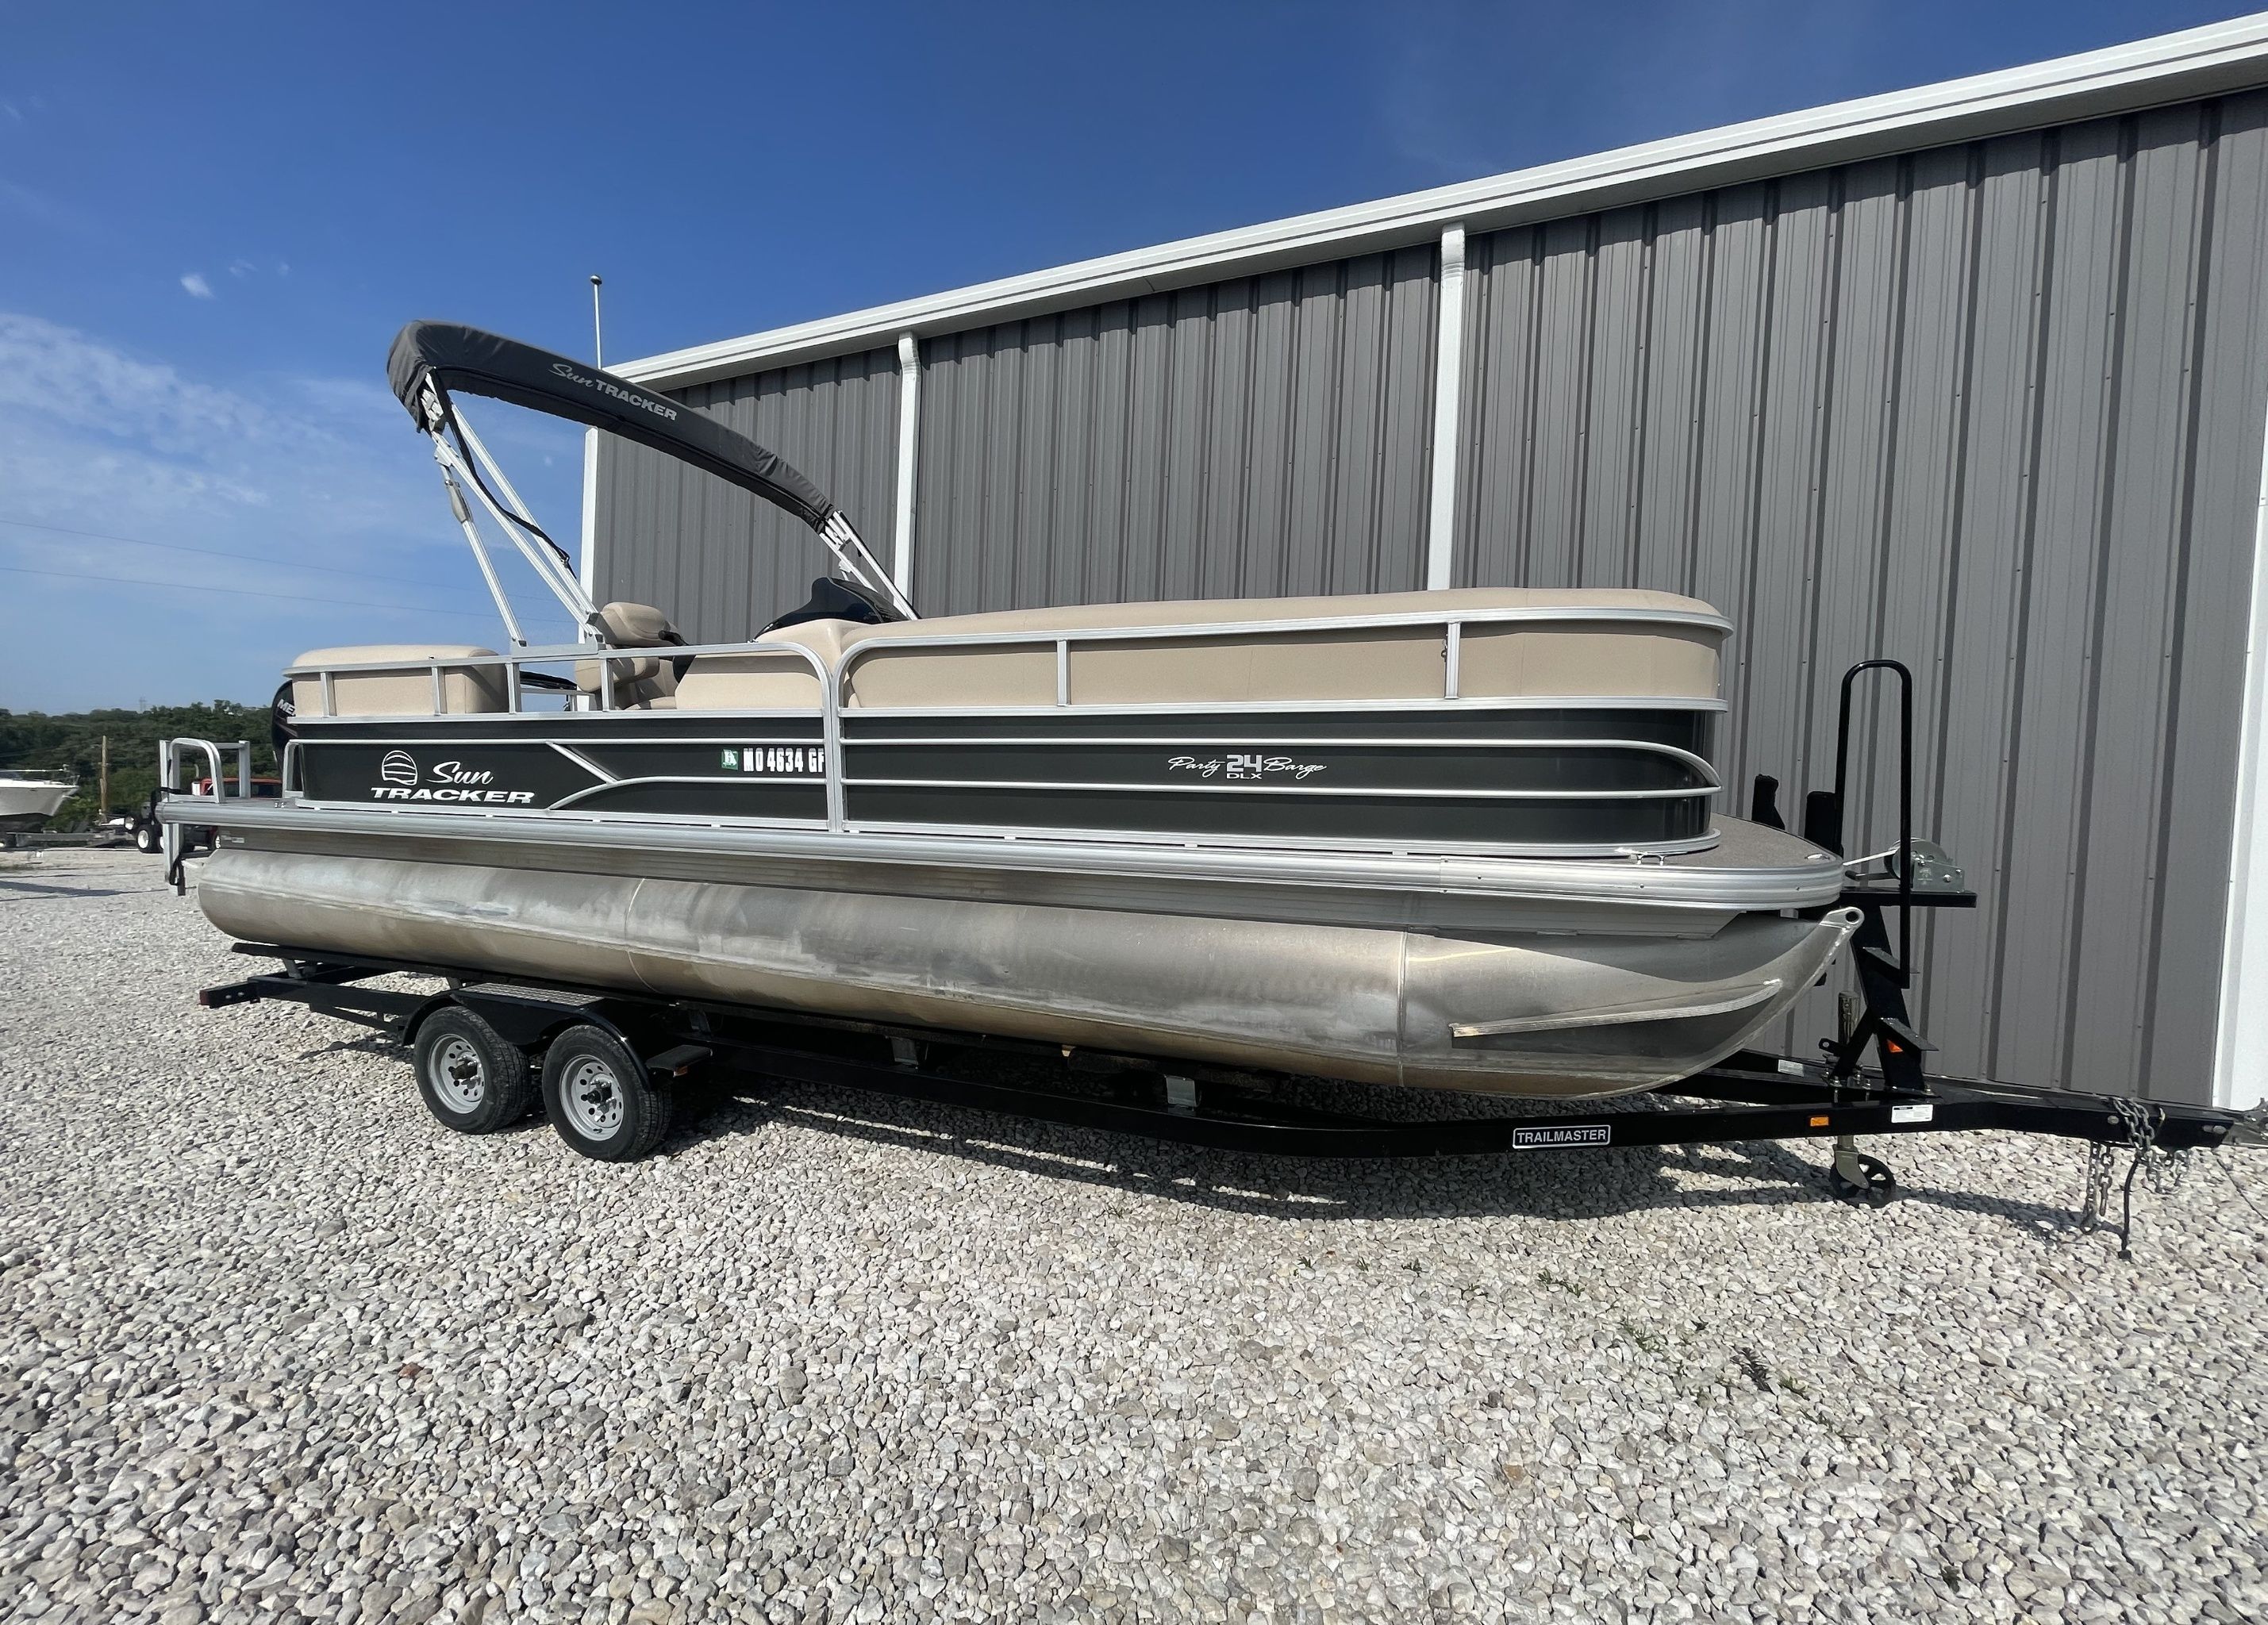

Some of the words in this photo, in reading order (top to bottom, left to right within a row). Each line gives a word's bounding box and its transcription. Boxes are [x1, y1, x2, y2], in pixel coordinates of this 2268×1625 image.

[548, 363, 594, 388] Sun
[595, 378, 677, 421] TRACKER
[743, 747, 764, 772] MO
[767, 747, 804, 773] 4634
[1167, 756, 1225, 778] Party
[1226, 755, 1263, 773] 24
[1263, 756, 1328, 780] Barge
[425, 761, 494, 786] Sun
[371, 787, 535, 804] TRACKER
[1516, 1129, 1606, 1143] TRAILMASTER
